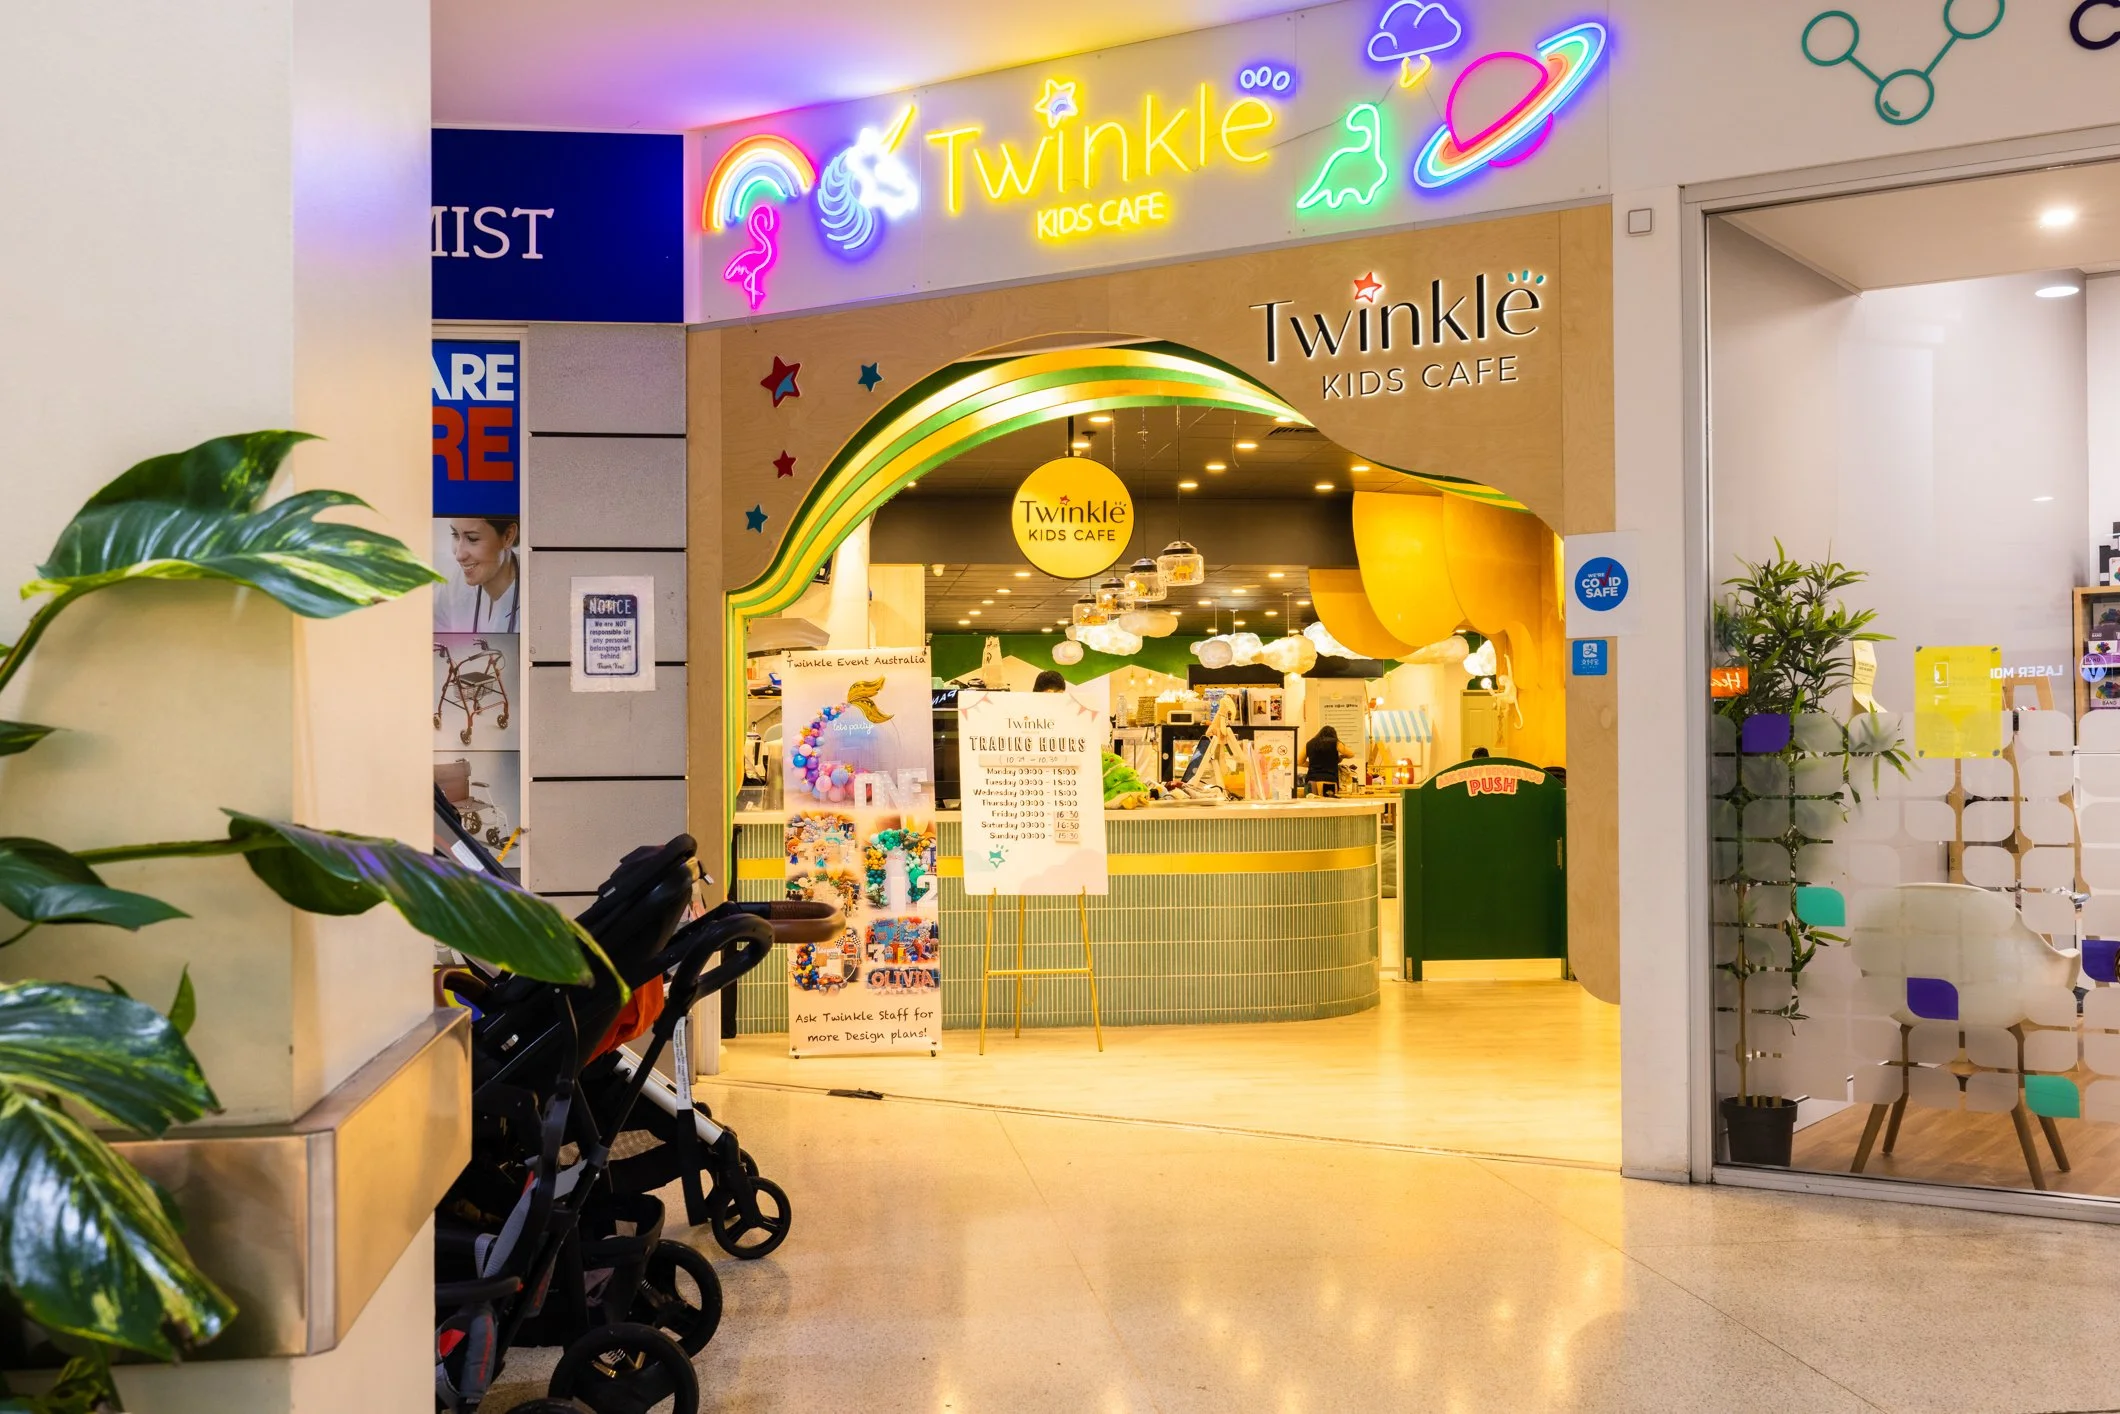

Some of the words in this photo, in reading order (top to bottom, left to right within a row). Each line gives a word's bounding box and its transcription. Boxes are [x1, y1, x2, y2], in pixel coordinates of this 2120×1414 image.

[926, 79, 1275, 213] Twinkle
[1036, 203, 1093, 240] KIDS
[1098, 192, 1165, 229] CAFE
[1248, 272, 1542, 362] Twinkle
[1322, 367, 1405, 400] KIDS
[1422, 355, 1519, 389] CAFE
[1020, 496, 1125, 523] Twinkle
[1028, 529, 1066, 541] KIDS
[1074, 529, 1116, 541] CAFE
[1586, 587, 1618, 598] SAFE
[589, 599, 632, 614] NOTICE
[787, 659, 832, 668] Twinkle
[837, 657, 869, 667] Event
[874, 655, 926, 665] Australia
[1005, 716, 1054, 729] Twinkle
[969, 736, 1032, 752] TRADING
[1039, 737, 1086, 752] HOURS
[987, 768, 1016, 776] Monday
[854, 768, 929, 809] ONE
[985, 779, 1016, 787] Tuesday
[1470, 777, 1516, 794] PUSH
[973, 789, 1017, 797] Wednesday
[982, 799, 1017, 808] Thursday
[991, 810, 1018, 819] Friday
[981, 821, 1018, 830] Saturday
[990, 832, 1018, 840] Sunday
[871, 968, 935, 988] OLIVIA
[795, 1014, 817, 1023] Ask
[823, 1010, 873, 1022] Twinkle
[878, 1008, 909, 1021] Staff
[914, 1007, 934, 1019] for
[807, 1033, 839, 1042] more
[845, 1031, 885, 1043] Design
[891, 1027, 927, 1044] plans!
